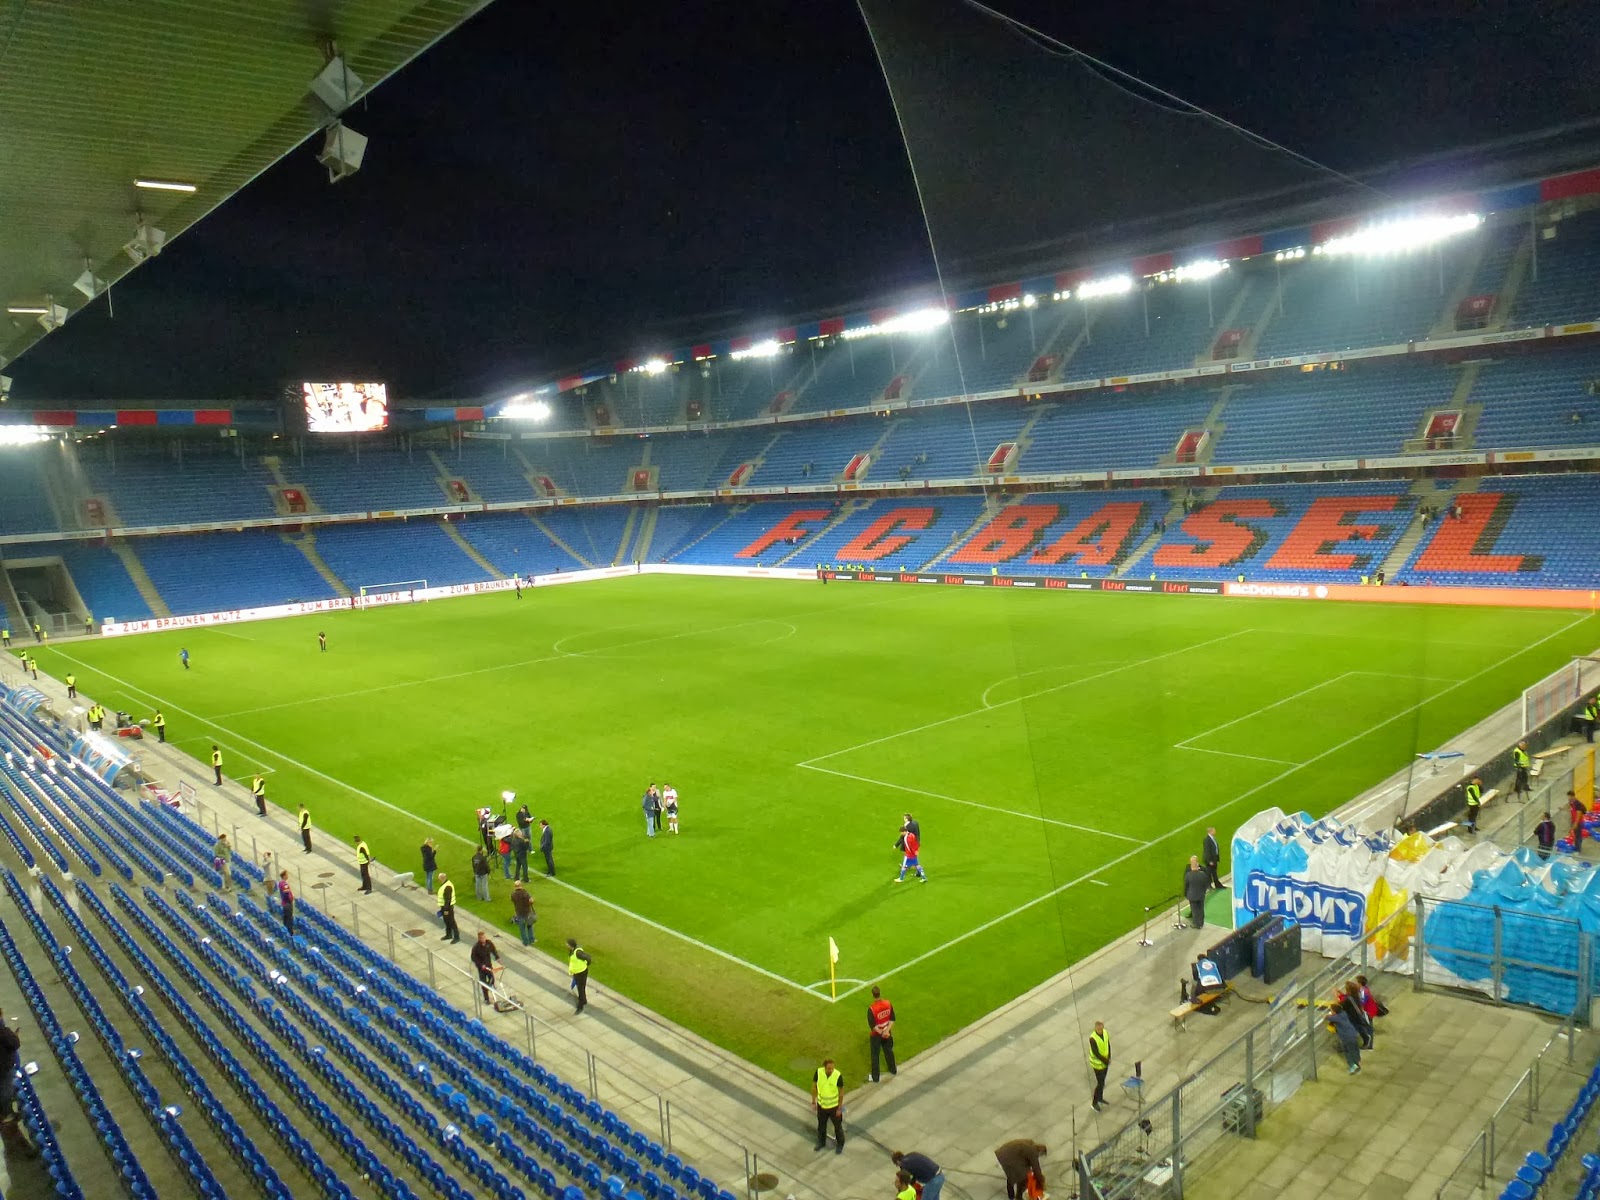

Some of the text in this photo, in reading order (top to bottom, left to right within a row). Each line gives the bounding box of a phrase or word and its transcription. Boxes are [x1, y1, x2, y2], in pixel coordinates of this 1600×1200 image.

[1448, 455, 1479, 464] adidas
[948, 493, 1529, 572] BASEL
[450, 584, 470, 594] ZUM
[474, 580, 511, 592] BRAUNEN
[1228, 583, 1310, 597] McDonald's
[300, 601, 323, 611] ZUM
[375, 592, 400, 602] MUTZ
[123, 610, 242, 632] ZUM BRAUNEN MUTZ
[1251, 878, 1359, 926] THOMY
